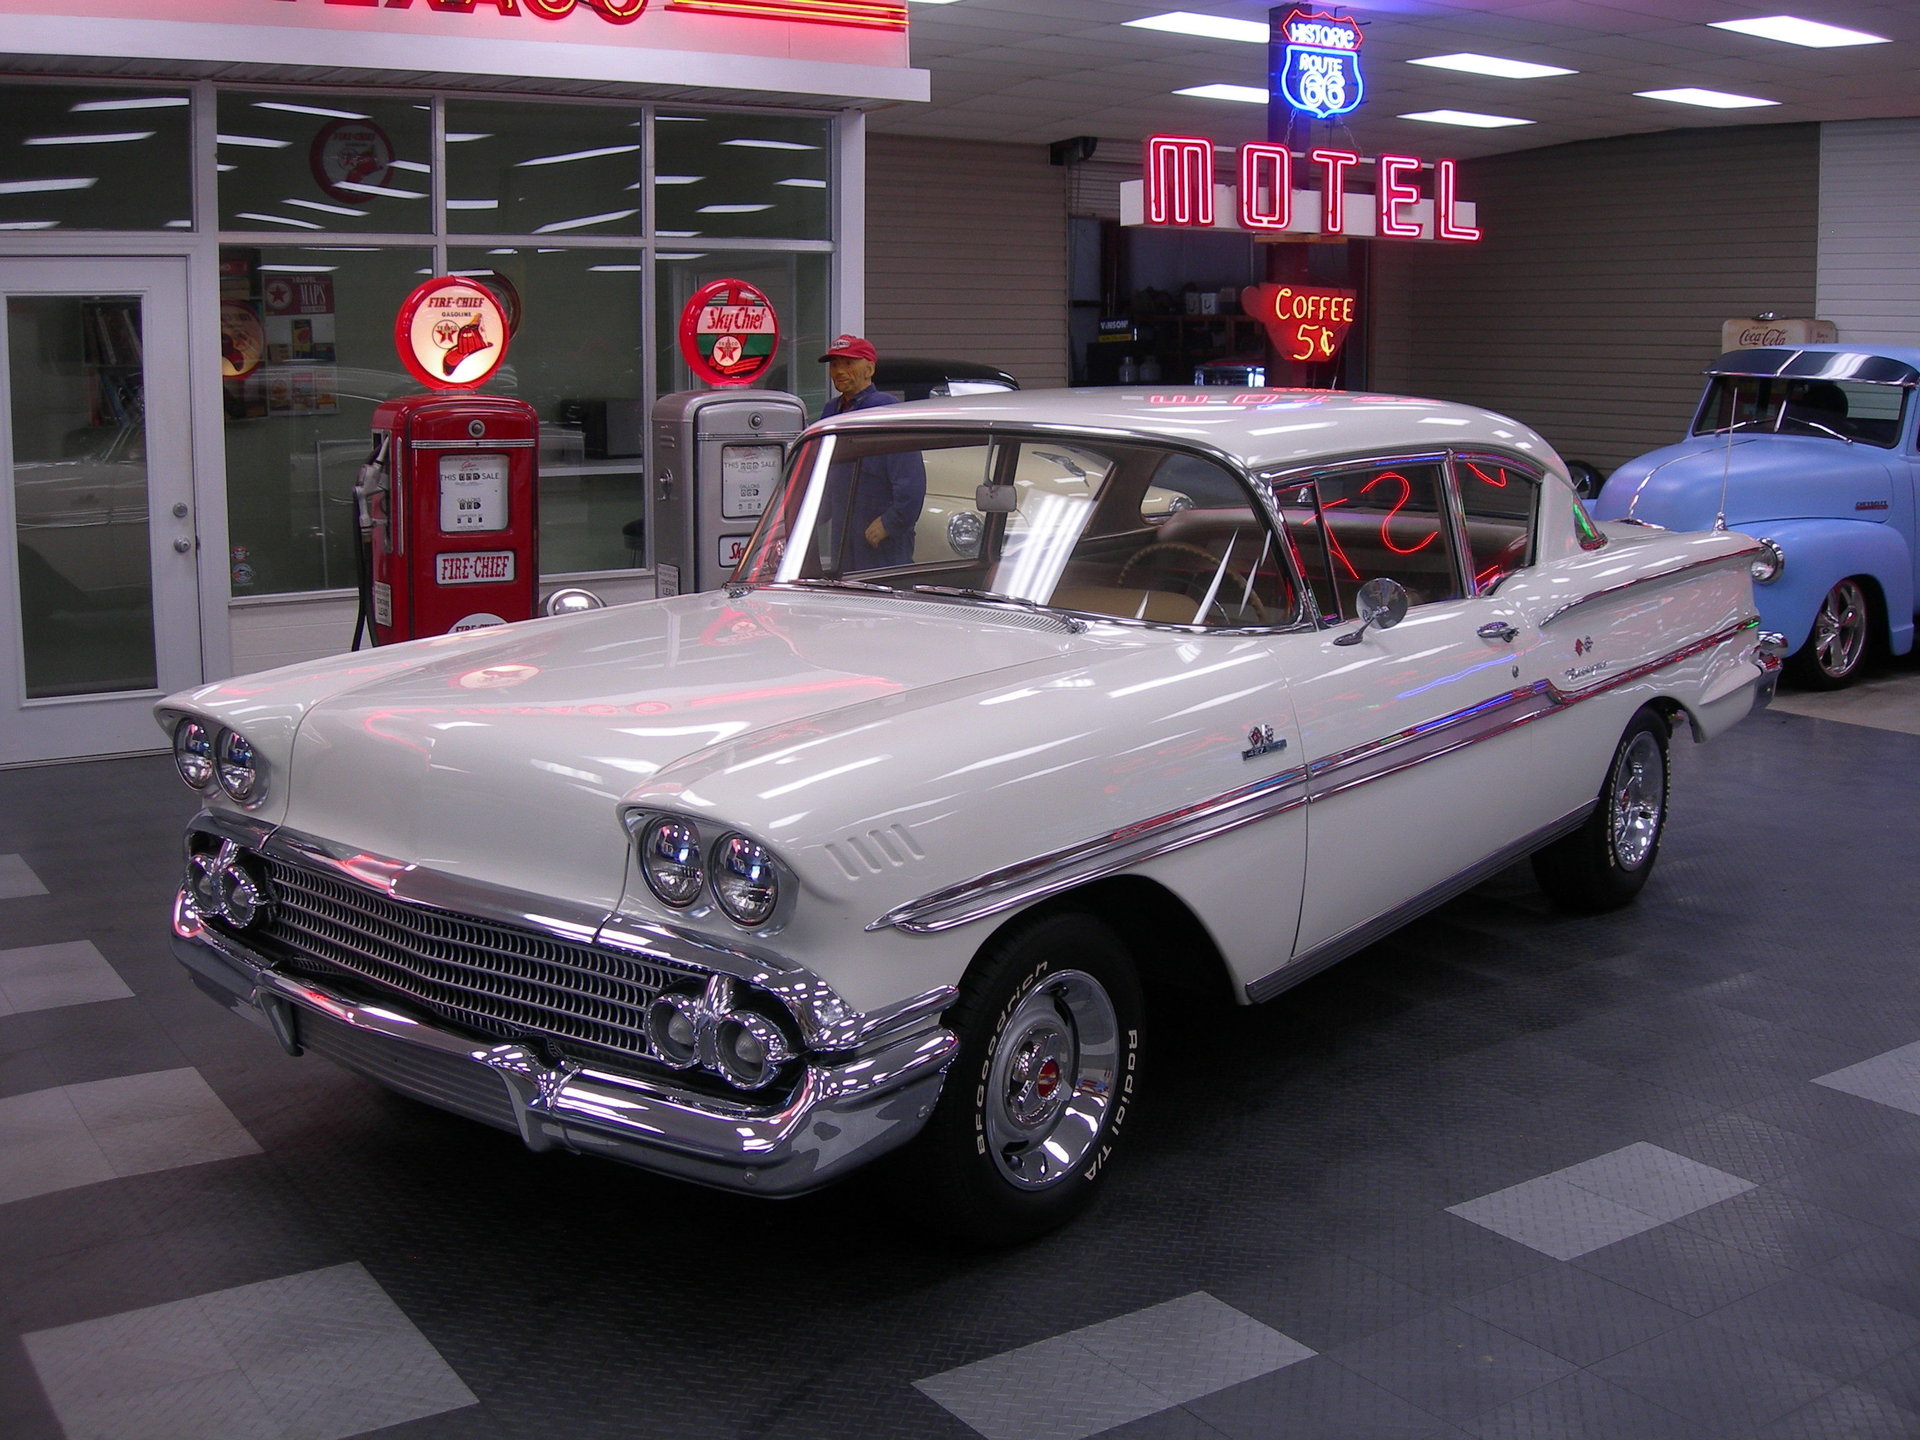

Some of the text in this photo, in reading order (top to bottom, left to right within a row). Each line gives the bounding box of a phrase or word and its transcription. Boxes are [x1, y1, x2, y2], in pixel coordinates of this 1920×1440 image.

[1290, 22, 1355, 49] HISTORIC
[1299, 52, 1343, 74] ROUTE
[1300, 70, 1345, 109] 66
[1144, 134, 1483, 242] MOTEL
[428, 296, 485, 308] FIRE-CHIEF
[1275, 287, 1354, 322] COFFEE
[707, 306, 767, 332] Sky Chief
[1292, 323, 1336, 361] 5¢
[1739, 328, 1787, 346] Coca-Cola
[440, 473, 457, 481] THIS
[481, 472, 500, 480] SALE
[724, 461, 739, 469] THIS
[729, 541, 746, 559] Sk
[441, 555, 510, 580] FIRE-CHIEF
[976, 960, 1048, 1155] BFGoodrich
[1083, 1029, 1138, 1181] Radial T/A
